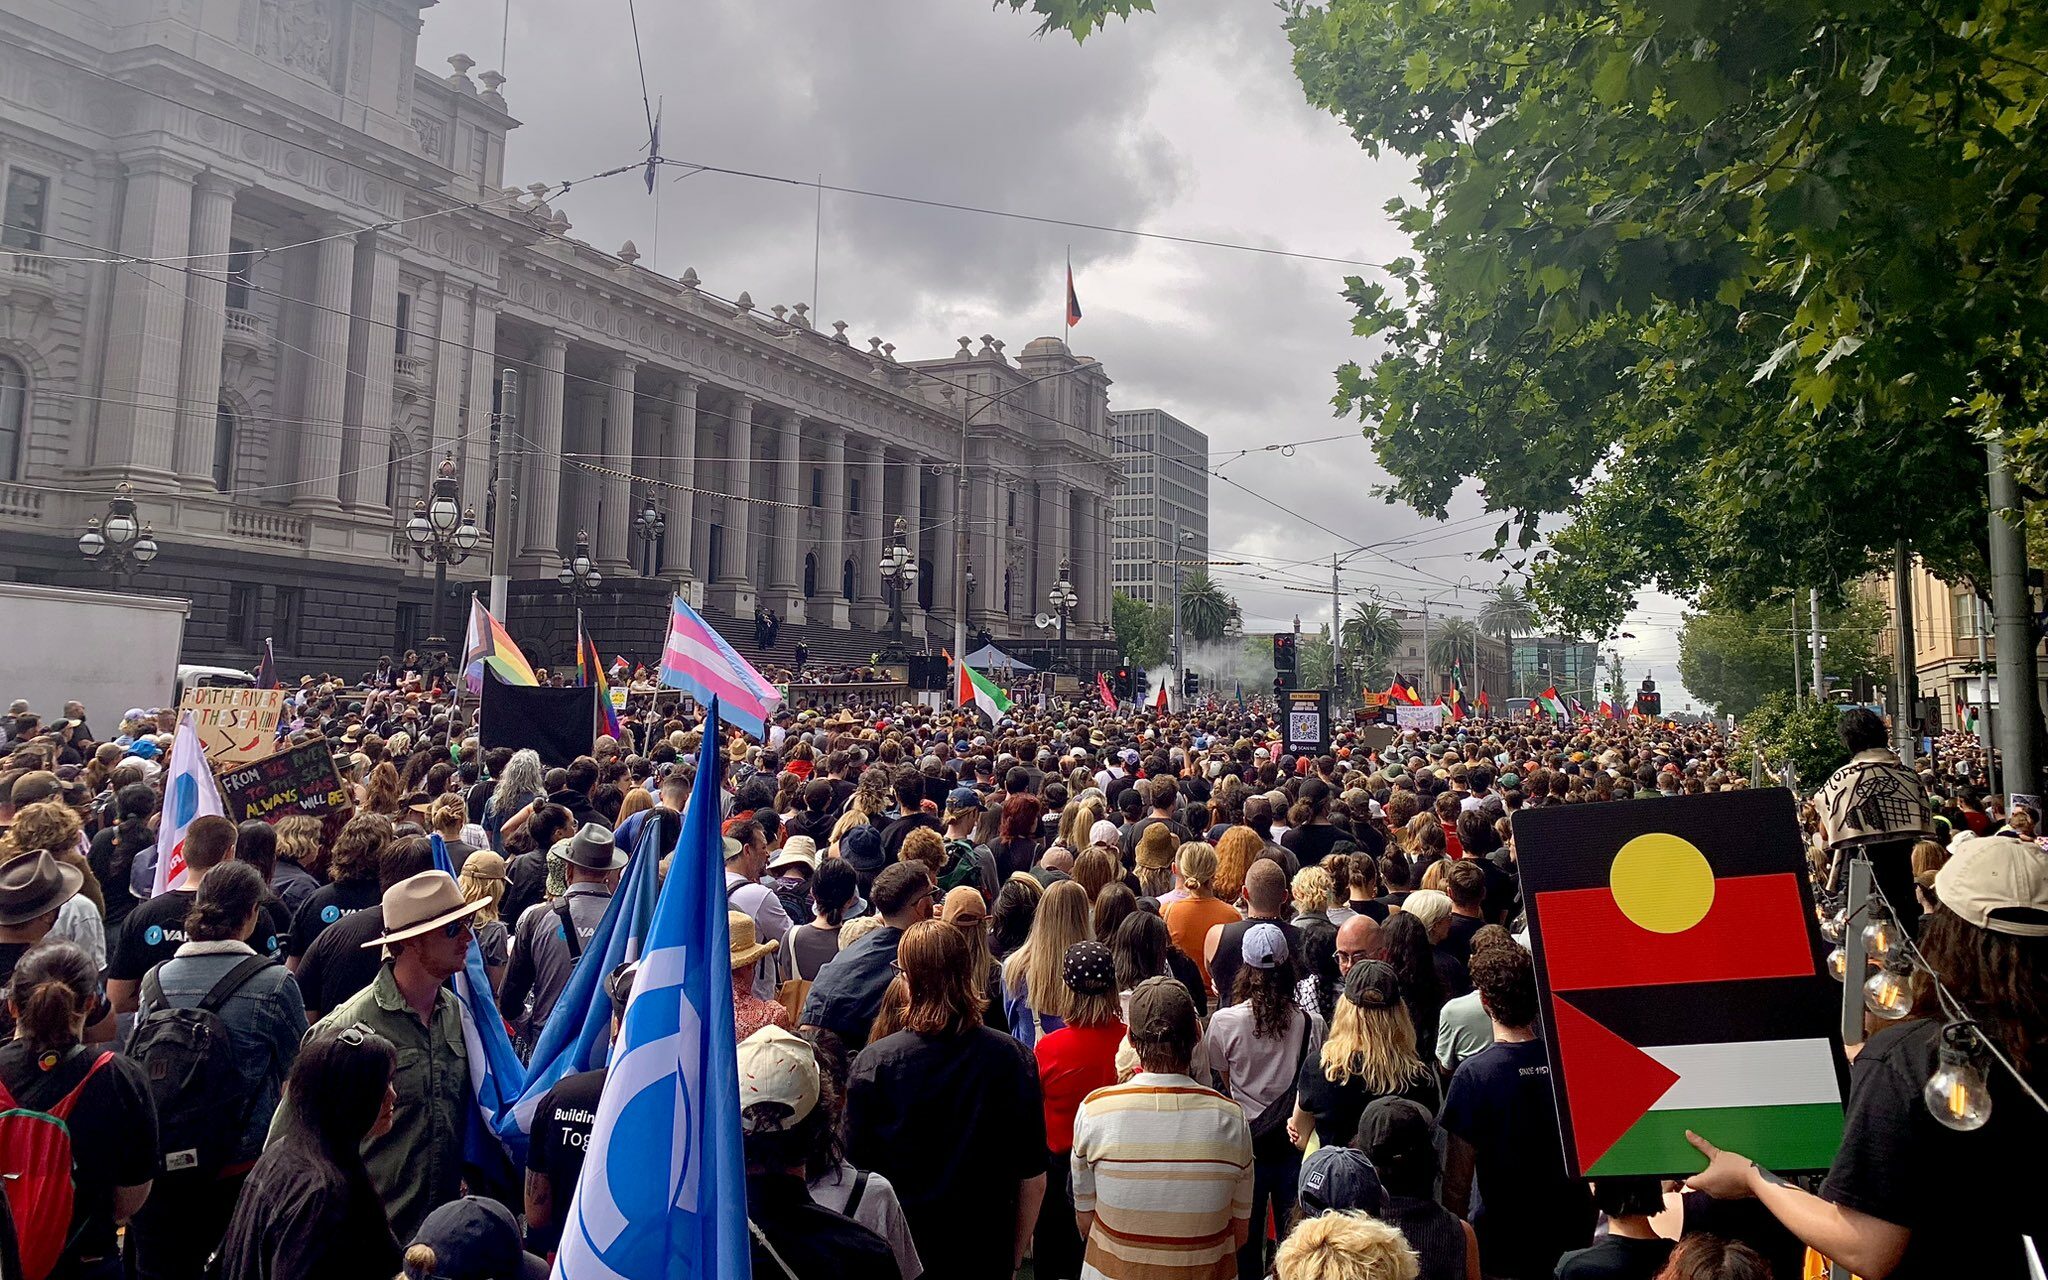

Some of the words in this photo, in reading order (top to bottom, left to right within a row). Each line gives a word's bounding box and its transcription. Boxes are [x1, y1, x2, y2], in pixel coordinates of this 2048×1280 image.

[241, 690, 279, 707] RIVER
[222, 768, 260, 794] FROM
[245, 784, 268, 800] TO
[301, 763, 331, 782] SEA
[246, 788, 298, 819] ALWAYS
[300, 793, 327, 810] WILL
[327, 790, 345, 806] BE
[554, 1108, 595, 1124] Buildin
